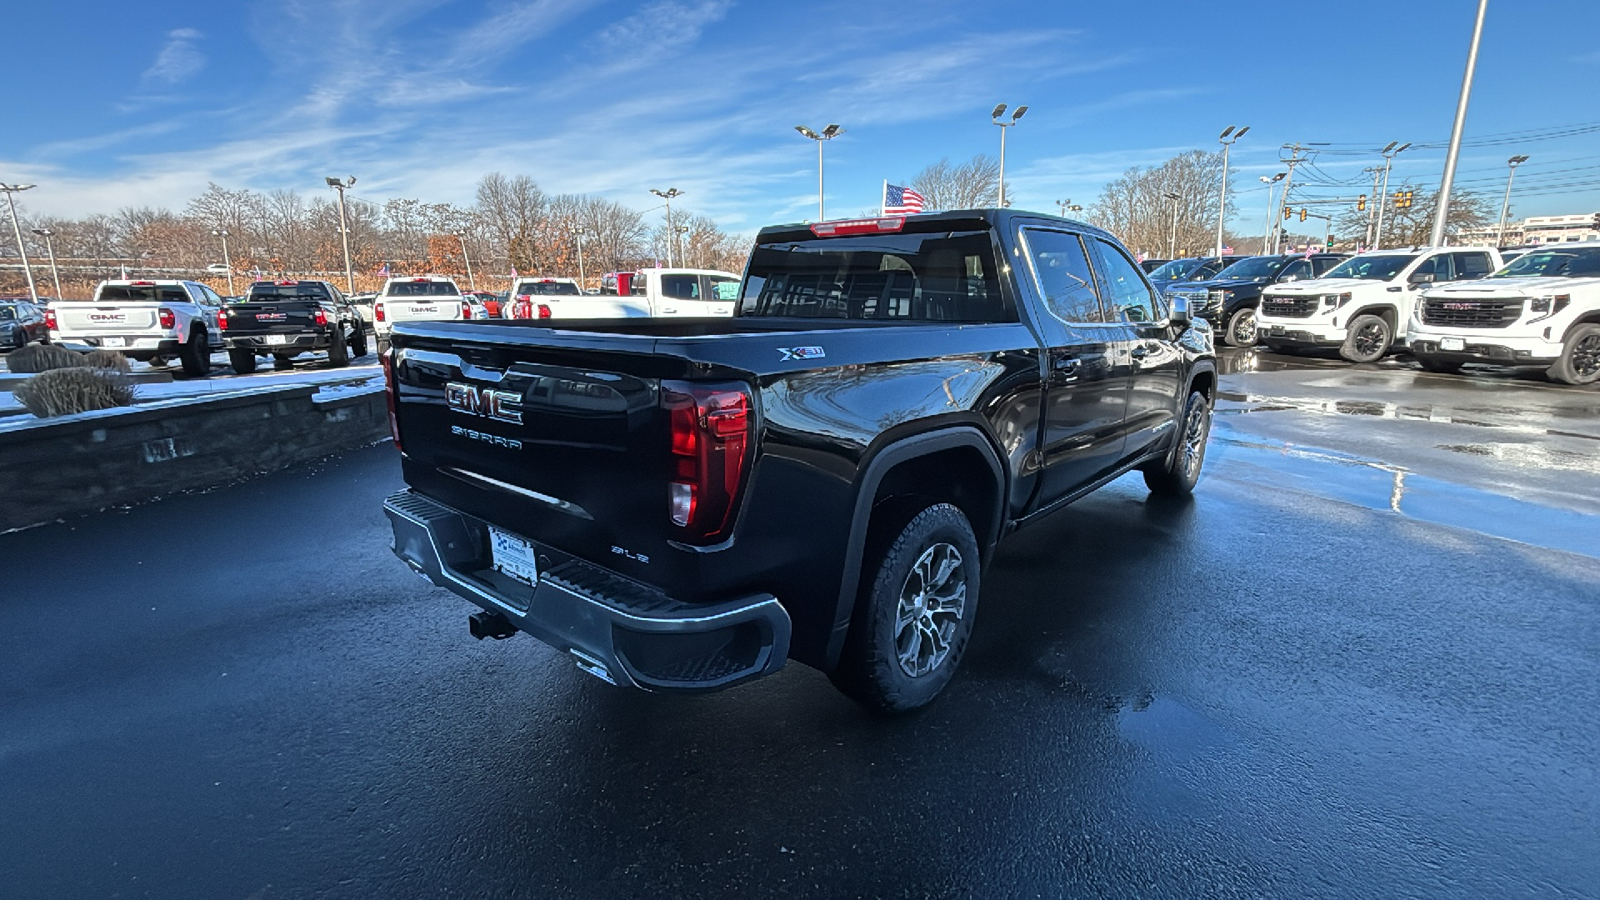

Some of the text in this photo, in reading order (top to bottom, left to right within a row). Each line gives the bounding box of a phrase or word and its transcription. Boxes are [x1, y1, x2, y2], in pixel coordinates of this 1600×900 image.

[445, 383, 524, 425] GMC
[451, 425, 522, 450] SIERRA
[611, 545, 649, 564] SLE
